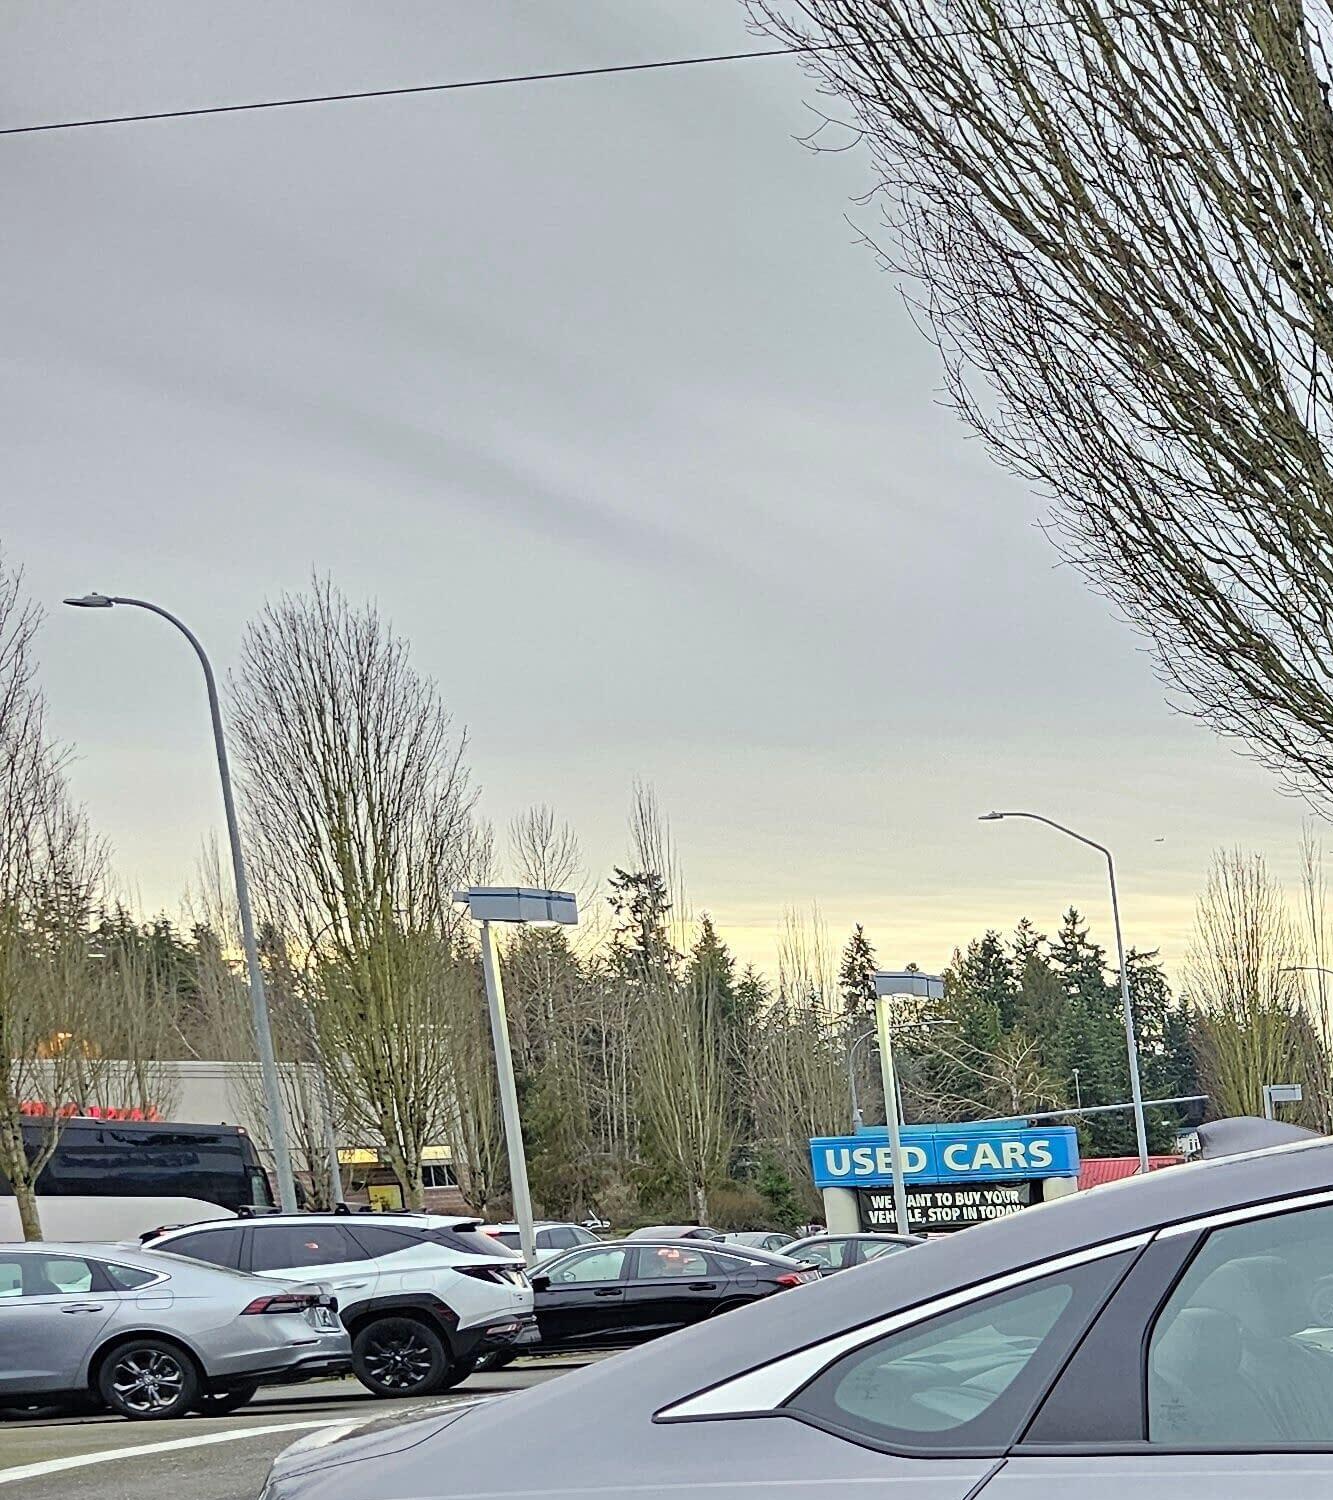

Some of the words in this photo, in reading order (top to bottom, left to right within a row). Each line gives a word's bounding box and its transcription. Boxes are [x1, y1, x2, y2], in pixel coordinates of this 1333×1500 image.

[825, 1146, 927, 1176] USED
[943, 1140, 1053, 1171] CARS
[870, 1195, 892, 1209] WE
[906, 1193, 932, 1207] ANT
[934, 1193, 950, 1207] TO
[955, 1191, 981, 1206] BUY
[983, 1190, 1020, 1204] YOUR
[868, 1208, 927, 1224] VEHLE,
[928, 1206, 960, 1223] STOP
[962, 1206, 978, 1220] IN
